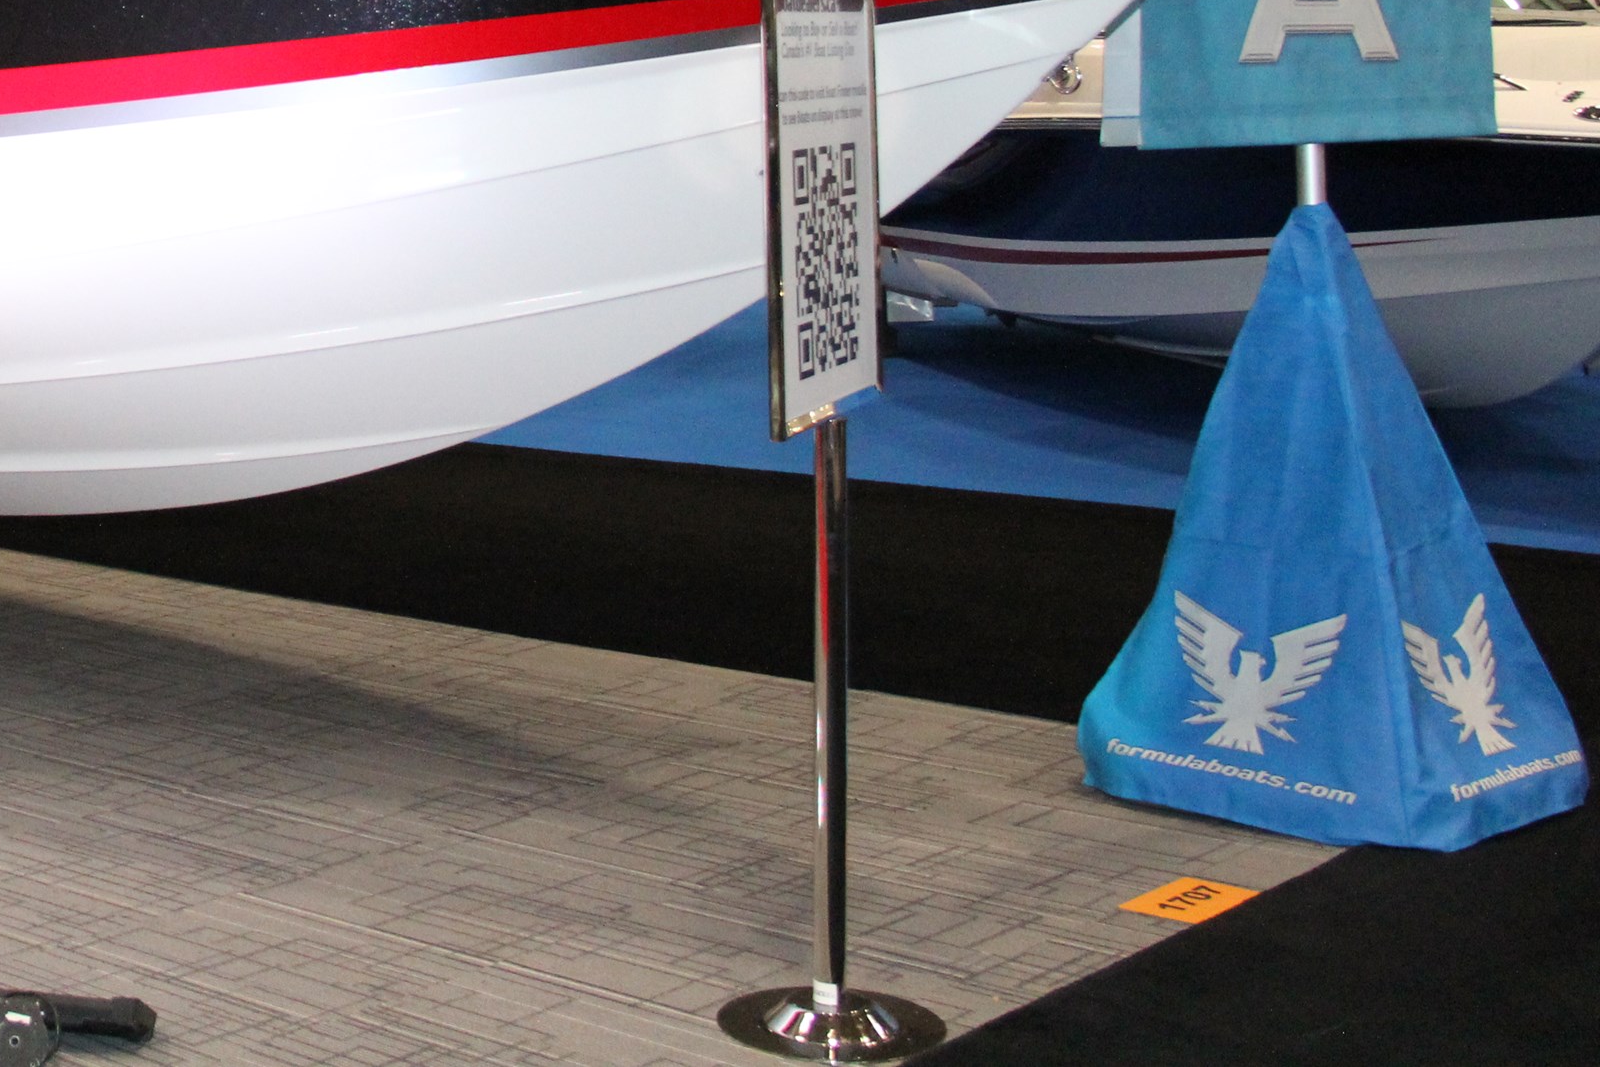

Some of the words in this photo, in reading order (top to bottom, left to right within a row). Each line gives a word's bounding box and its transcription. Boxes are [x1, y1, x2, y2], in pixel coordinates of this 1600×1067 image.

[1106, 738, 1358, 805] formulaboats.com
[1450, 749, 1582, 802] formulaboats.com
[1158, 885, 1221, 910] 1707
